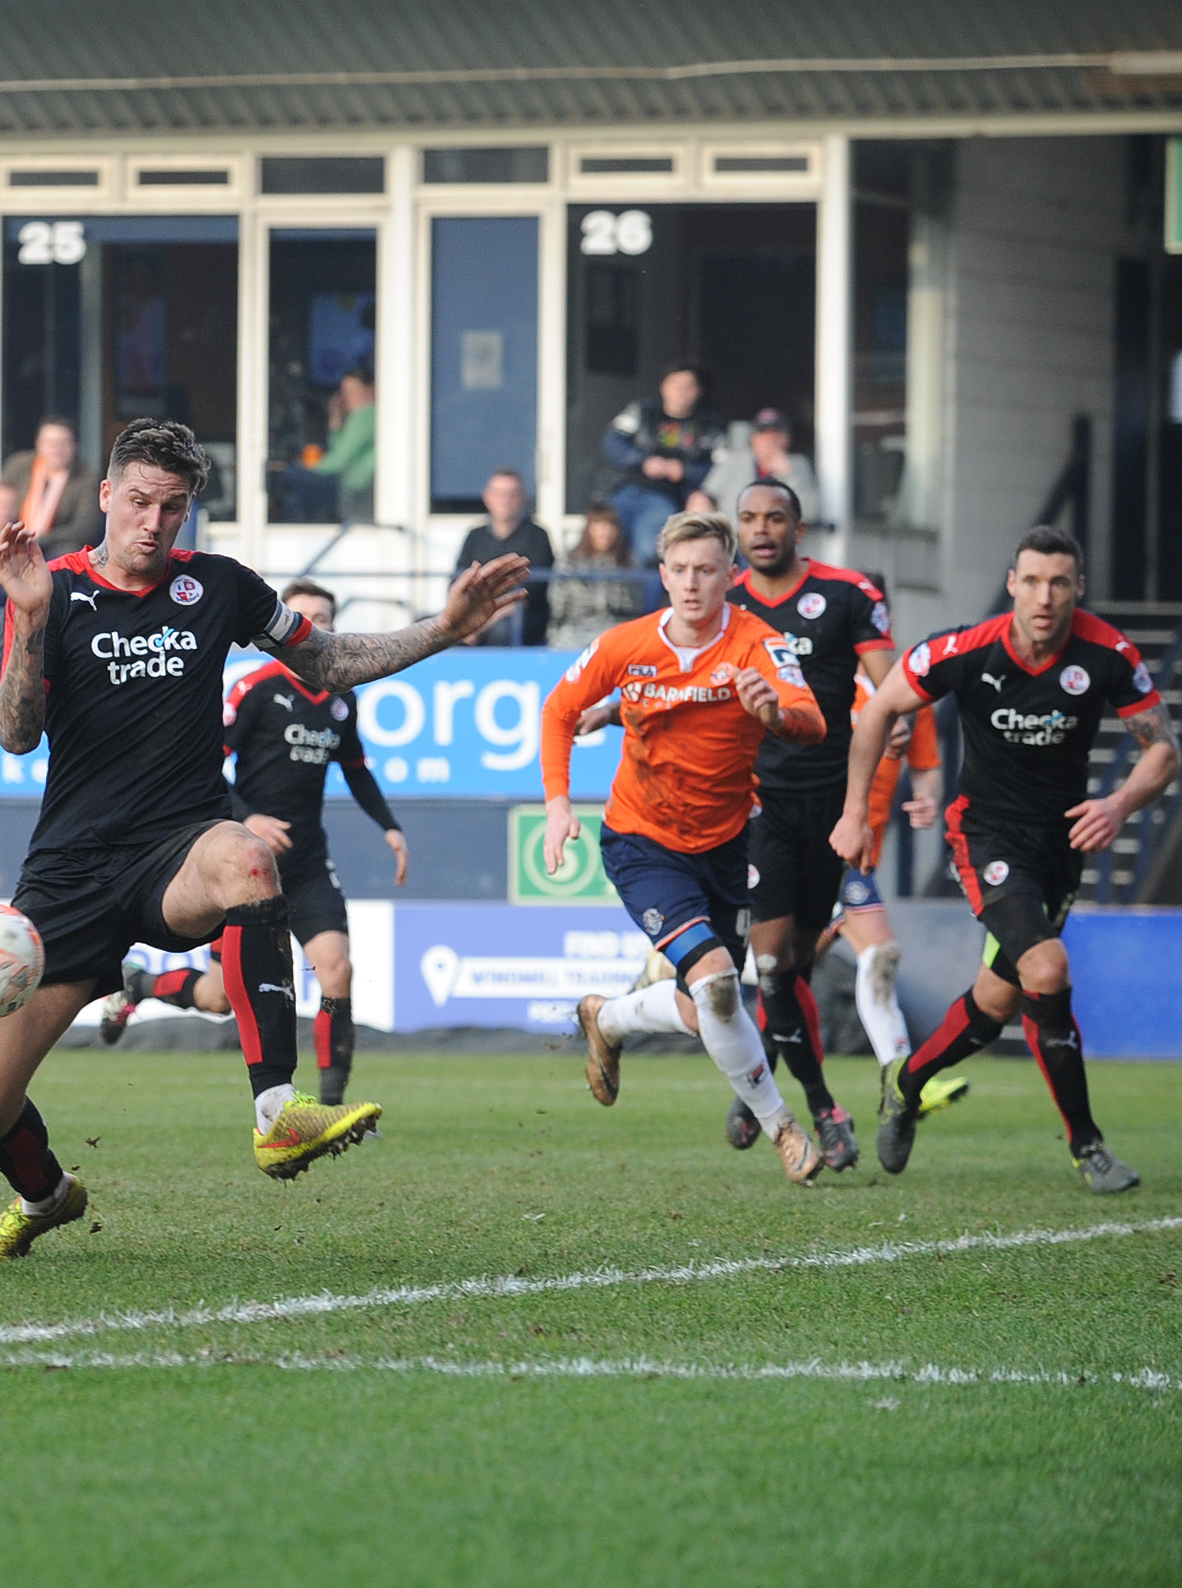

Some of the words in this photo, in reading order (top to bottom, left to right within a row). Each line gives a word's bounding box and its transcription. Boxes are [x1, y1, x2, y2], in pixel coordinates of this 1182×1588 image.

[17, 221, 86, 265] 25
[580, 209, 653, 255] 26
[91, 626, 198, 659] Checka
[107, 650, 185, 685] trade
